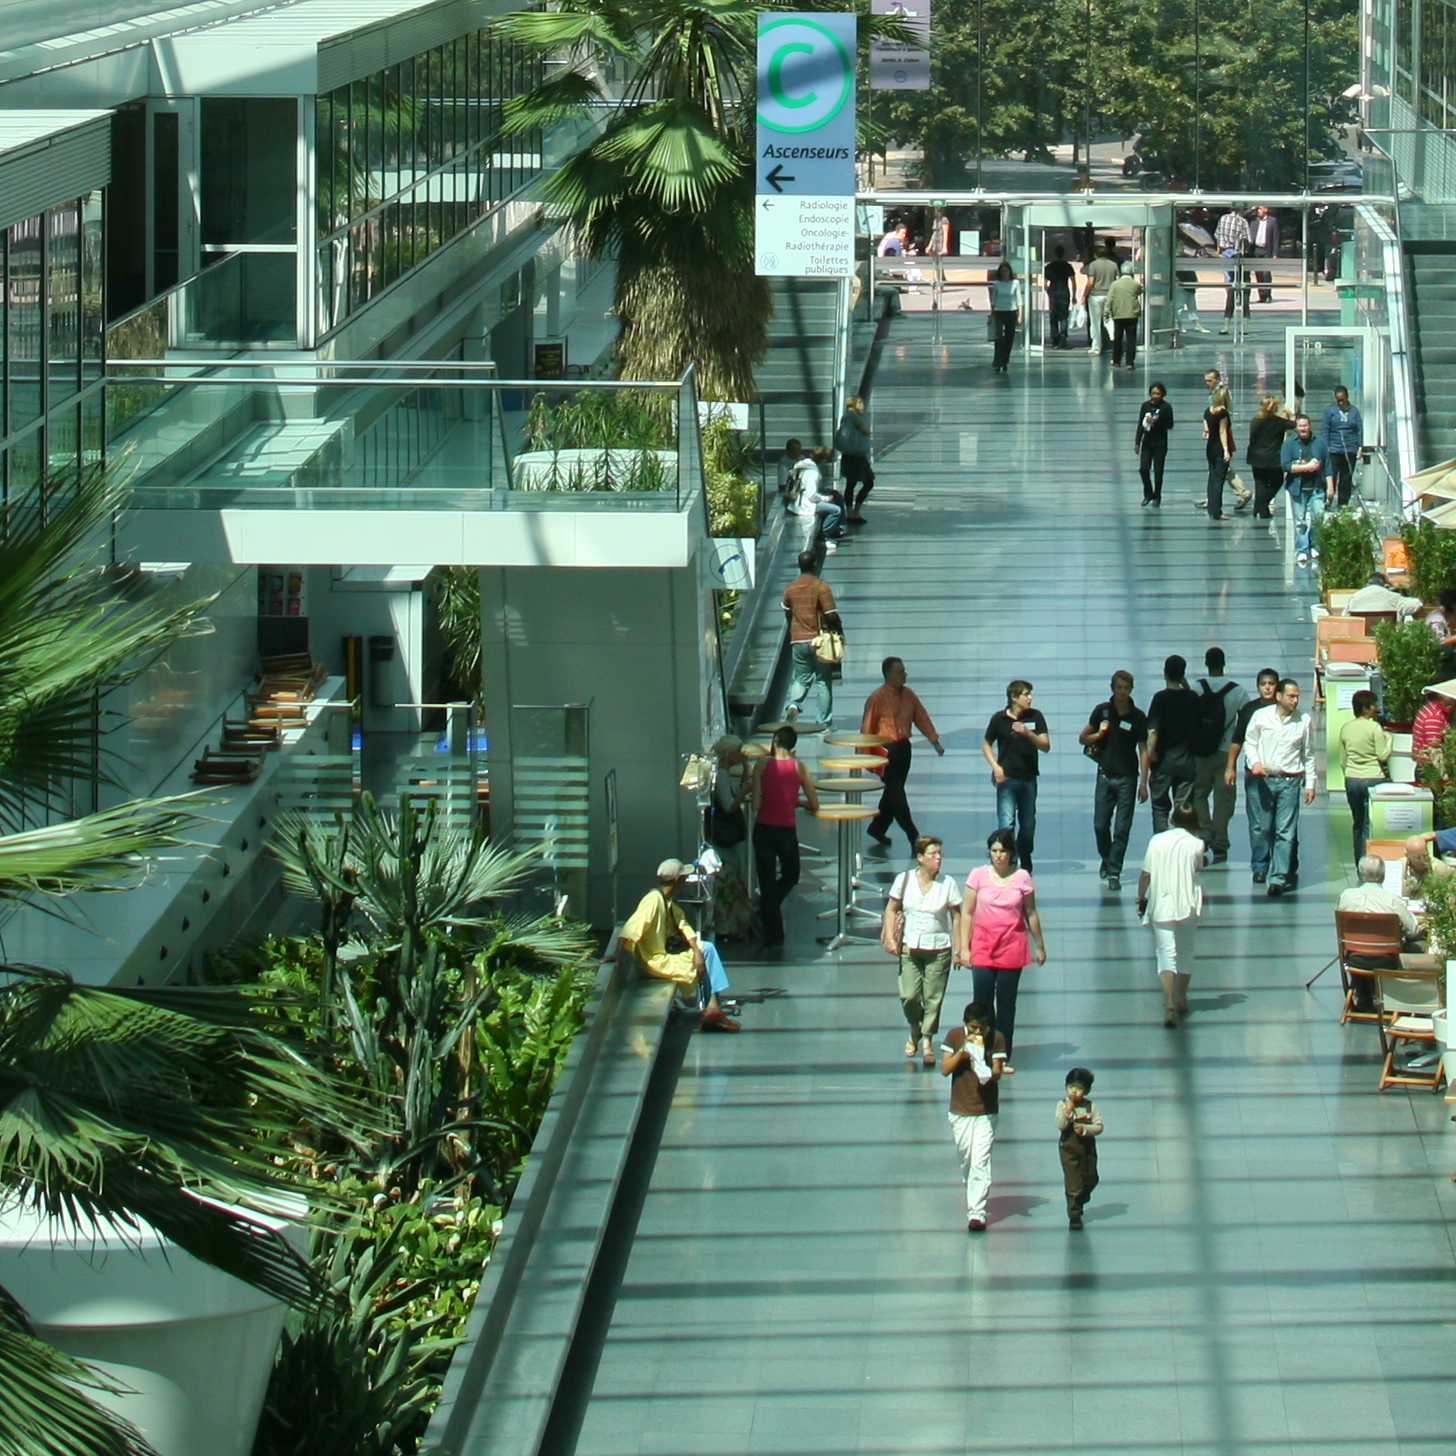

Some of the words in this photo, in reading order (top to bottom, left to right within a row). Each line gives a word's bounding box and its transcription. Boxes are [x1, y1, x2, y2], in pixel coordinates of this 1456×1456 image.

[768, 42, 817, 108] C
[762, 144, 849, 159] Ascenseurs
[800, 201, 849, 212] Radiologie
[799, 214, 850, 224] Endoscopie
[785, 242, 850, 253] Radiothérapie
[810, 256, 849, 265] Toilettes
[805, 265, 849, 276] publiques
